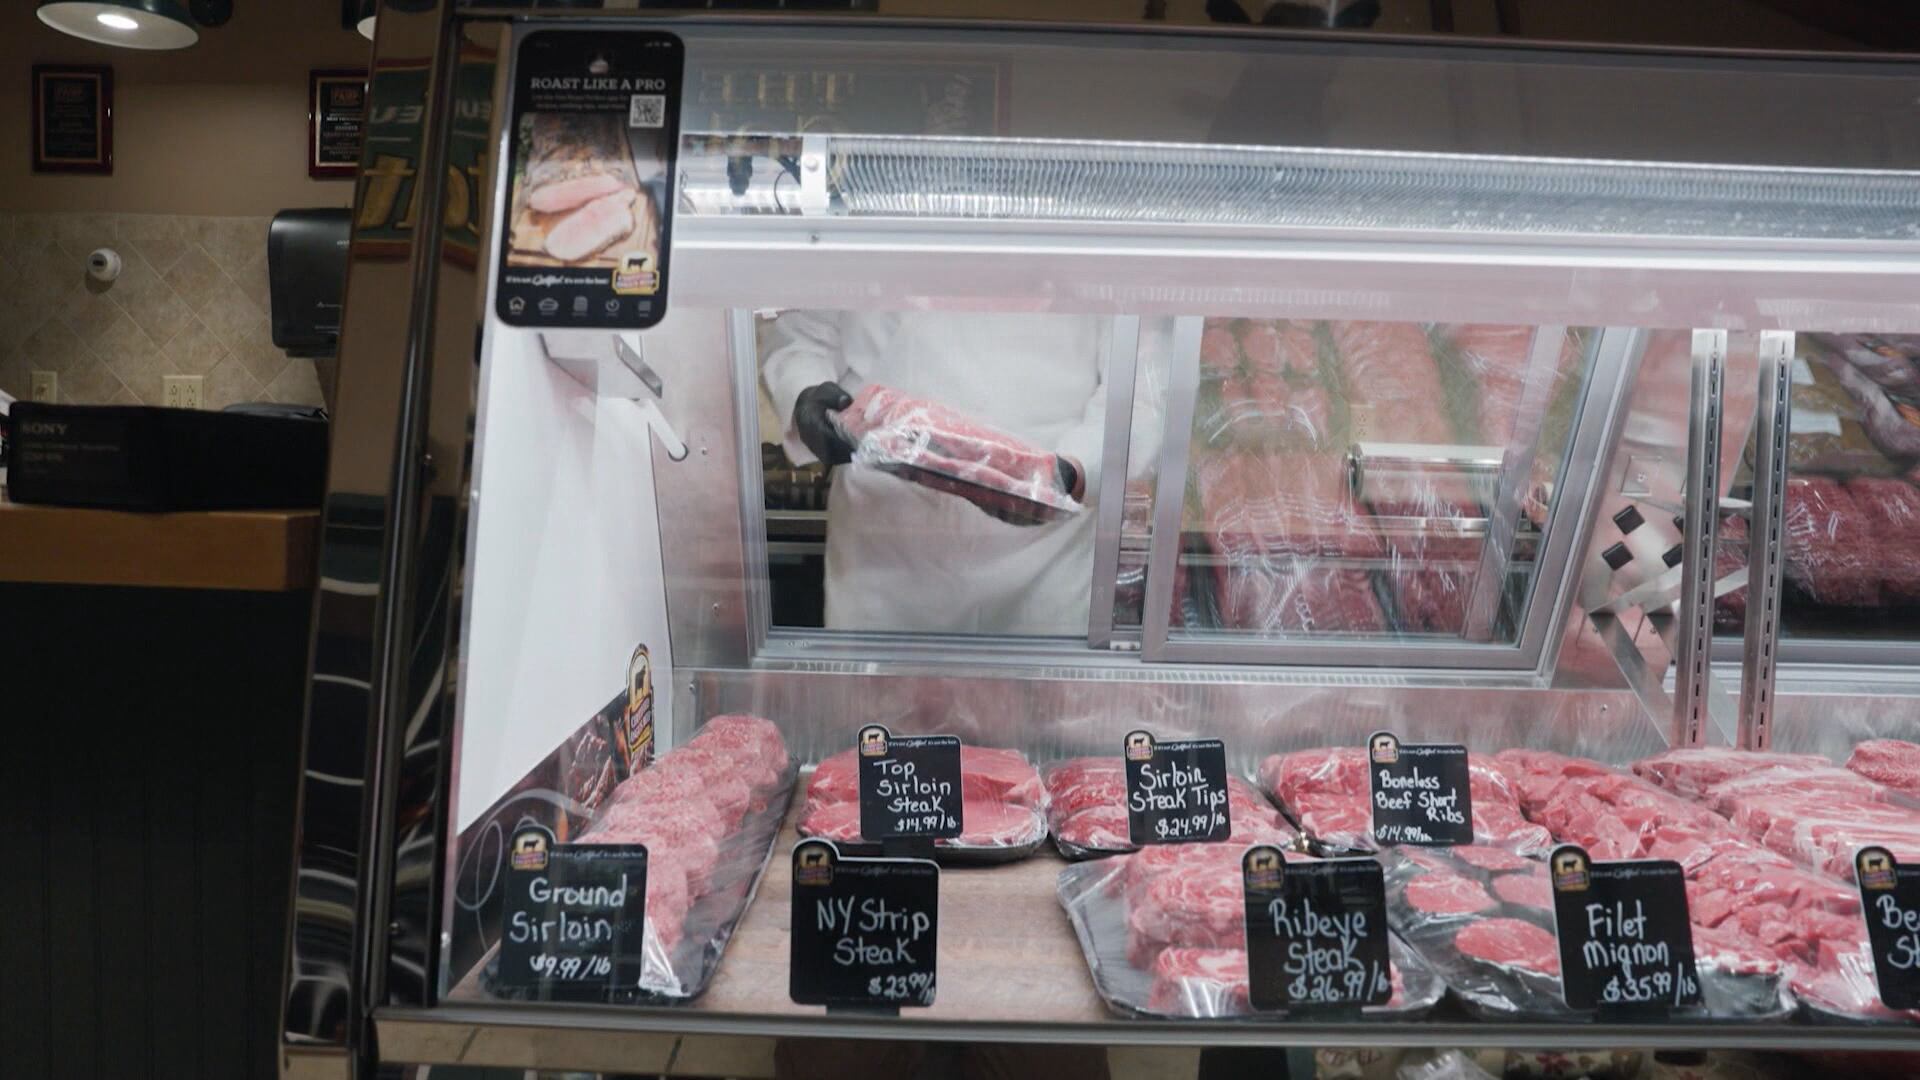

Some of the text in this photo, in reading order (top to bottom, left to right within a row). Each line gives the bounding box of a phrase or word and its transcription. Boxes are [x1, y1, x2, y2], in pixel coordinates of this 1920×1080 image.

[530, 77, 667, 91] ROAST LIKE A PRO
[873, 759, 915, 781] Top
[1139, 760, 1206, 790] Sirloin
[876, 775, 951, 797] Sirloin
[1130, 783, 1226, 813] Steak Tips
[1375, 788, 1457, 810] Beef Short
[887, 795, 945, 814] Steak
[1426, 806, 1465, 824] Ribs
[1155, 812, 1226, 838] $24.99/lb
[528, 873, 627, 908] Ground
[509, 911, 612, 944] Sirloin
[816, 895, 930, 941] NY Strip
[1268, 897, 1367, 939] Ribeye
[1585, 899, 1647, 939] Filet
[833, 937, 916, 966] Steak
[1283, 936, 1364, 975] Steak
